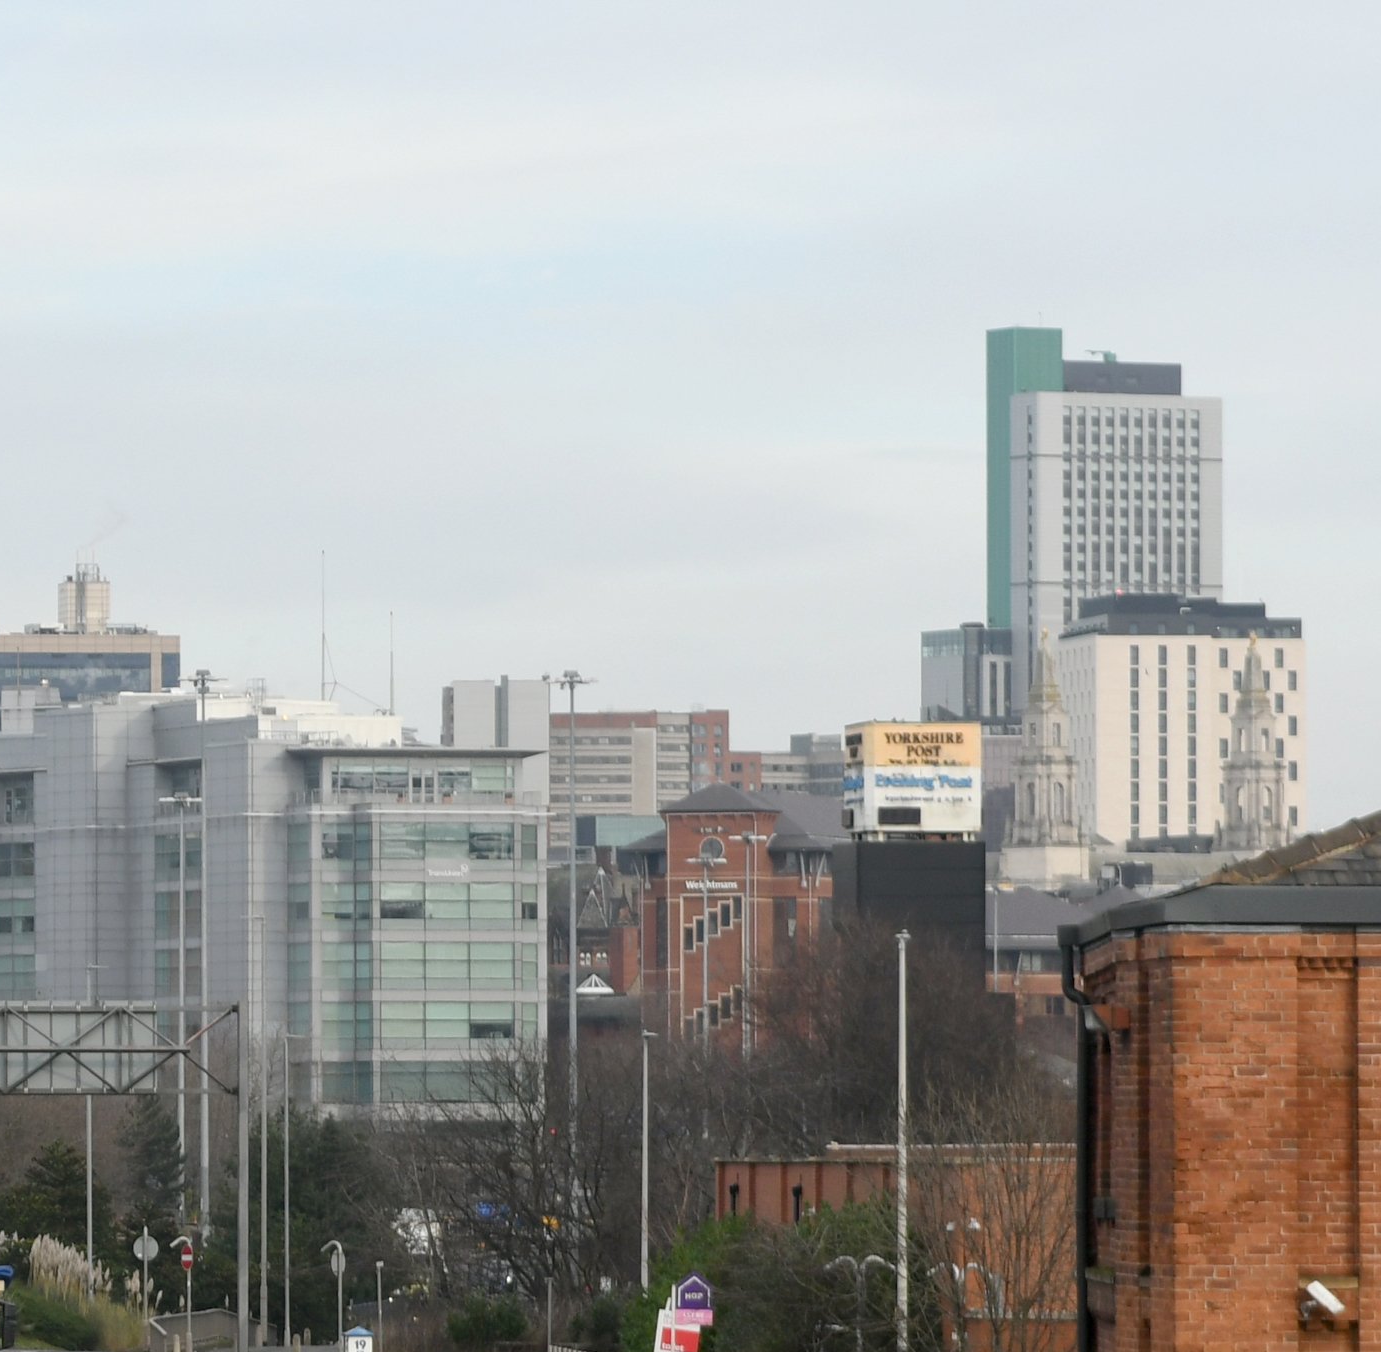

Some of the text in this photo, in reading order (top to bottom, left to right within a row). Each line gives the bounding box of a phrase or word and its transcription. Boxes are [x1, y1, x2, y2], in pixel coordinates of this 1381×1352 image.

[884, 732, 964, 744] YORKSHIRE
[906, 745, 941, 757] POST
[355, 1340, 366, 1349] 19
